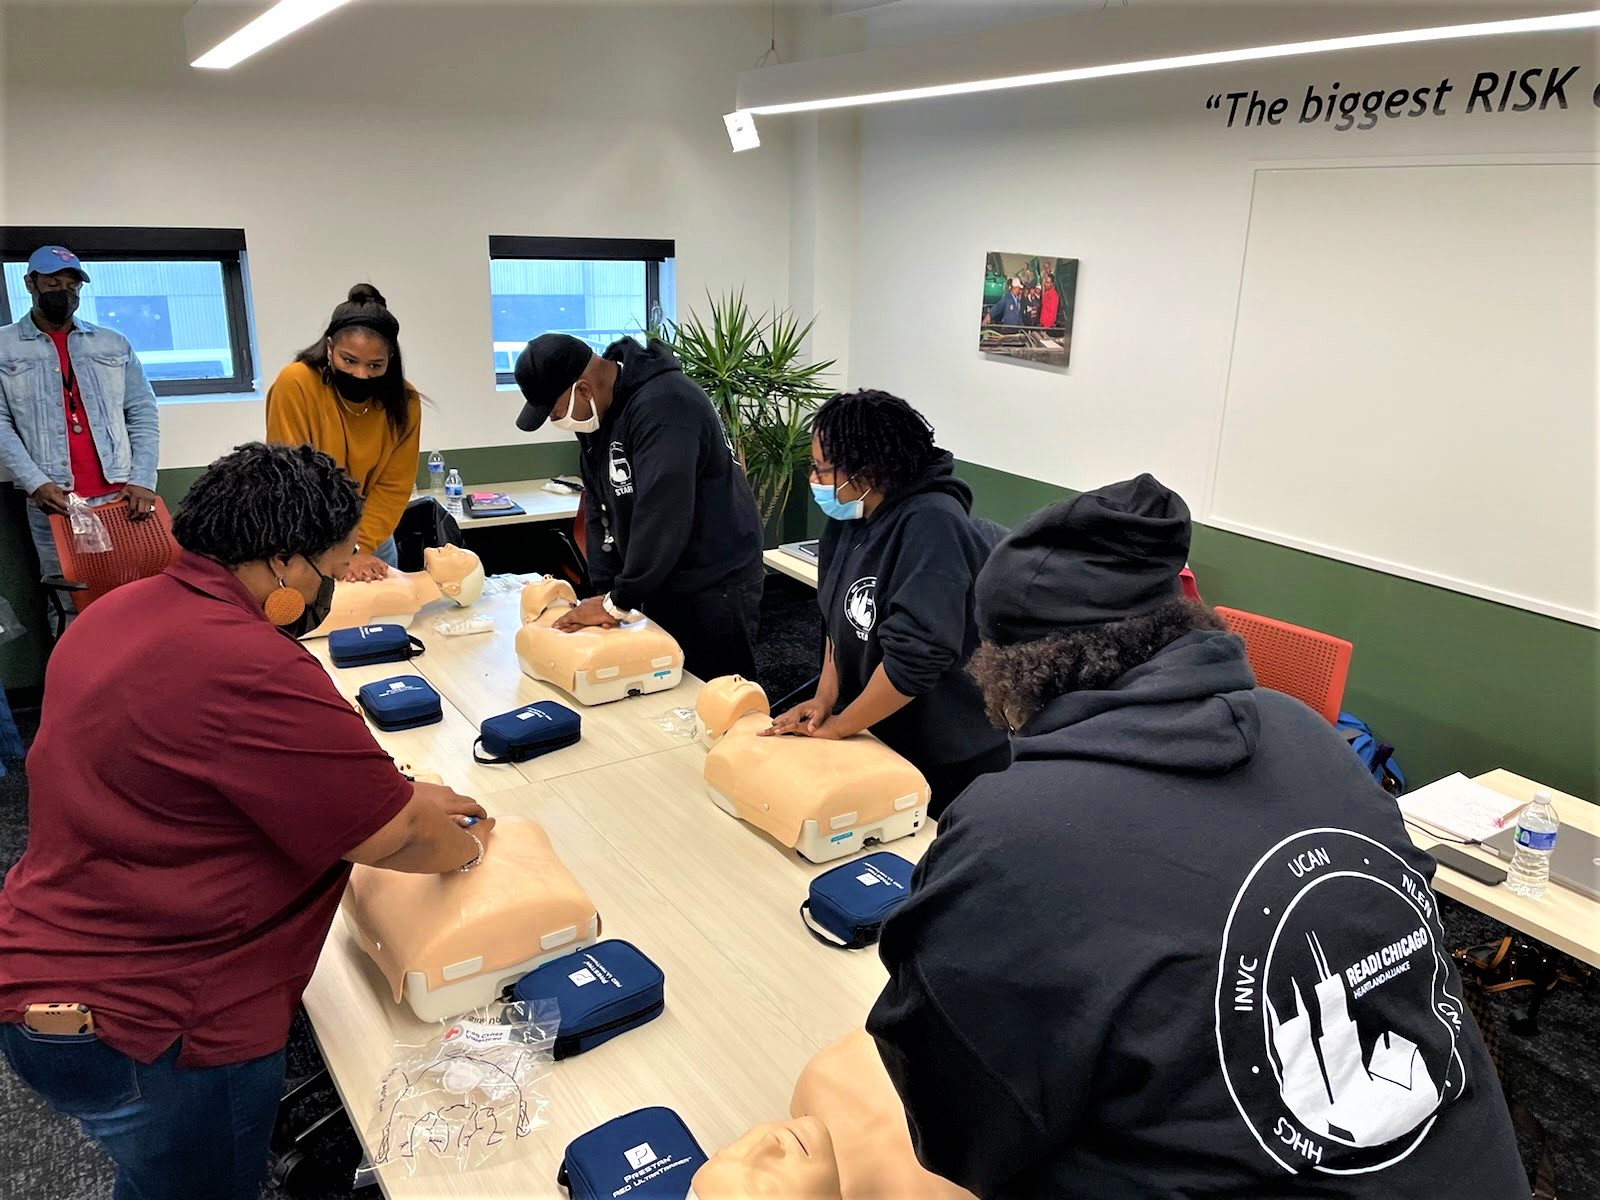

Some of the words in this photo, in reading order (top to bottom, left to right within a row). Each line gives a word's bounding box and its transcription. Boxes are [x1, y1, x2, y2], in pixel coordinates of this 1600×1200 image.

[1299, 79, 1453, 131] biggest
[1465, 65, 1581, 114] RISK
[1287, 847, 1331, 878] UCAN
[1401, 874, 1433, 918] NLEN
[1345, 951, 1383, 988] READI
[1381, 927, 1428, 966] CHICAGO
[1234, 954, 1258, 1012] INVC
[1353, 973, 1386, 1000] HEARTLAND
[1385, 960, 1411, 981] ALLIANCE
[1273, 1116, 1324, 1165] HHCS
[623, 1155, 672, 1183] PRESTAN
[612, 1185, 632, 1198] AED
